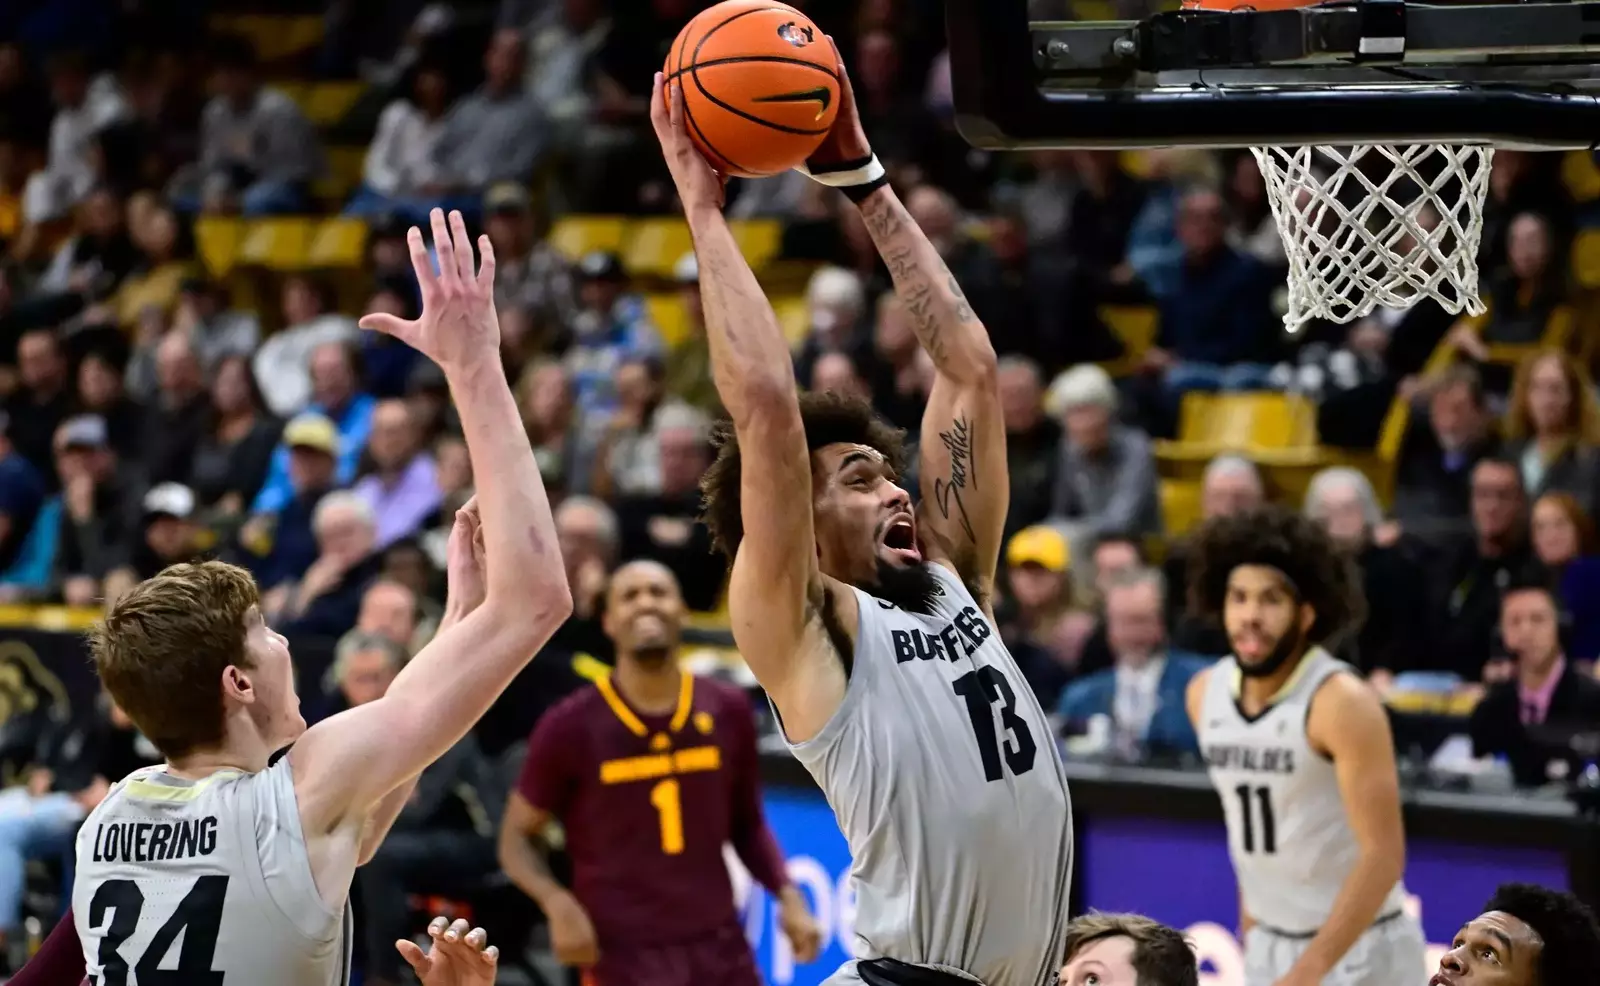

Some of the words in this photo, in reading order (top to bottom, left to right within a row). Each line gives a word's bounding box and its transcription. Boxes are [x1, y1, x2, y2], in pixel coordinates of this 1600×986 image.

[952, 664, 1037, 782] 13
[93, 815, 217, 862] LOVERING
[650, 778, 684, 856] 1
[1234, 784, 1277, 856] 11
[89, 875, 230, 986] 34
